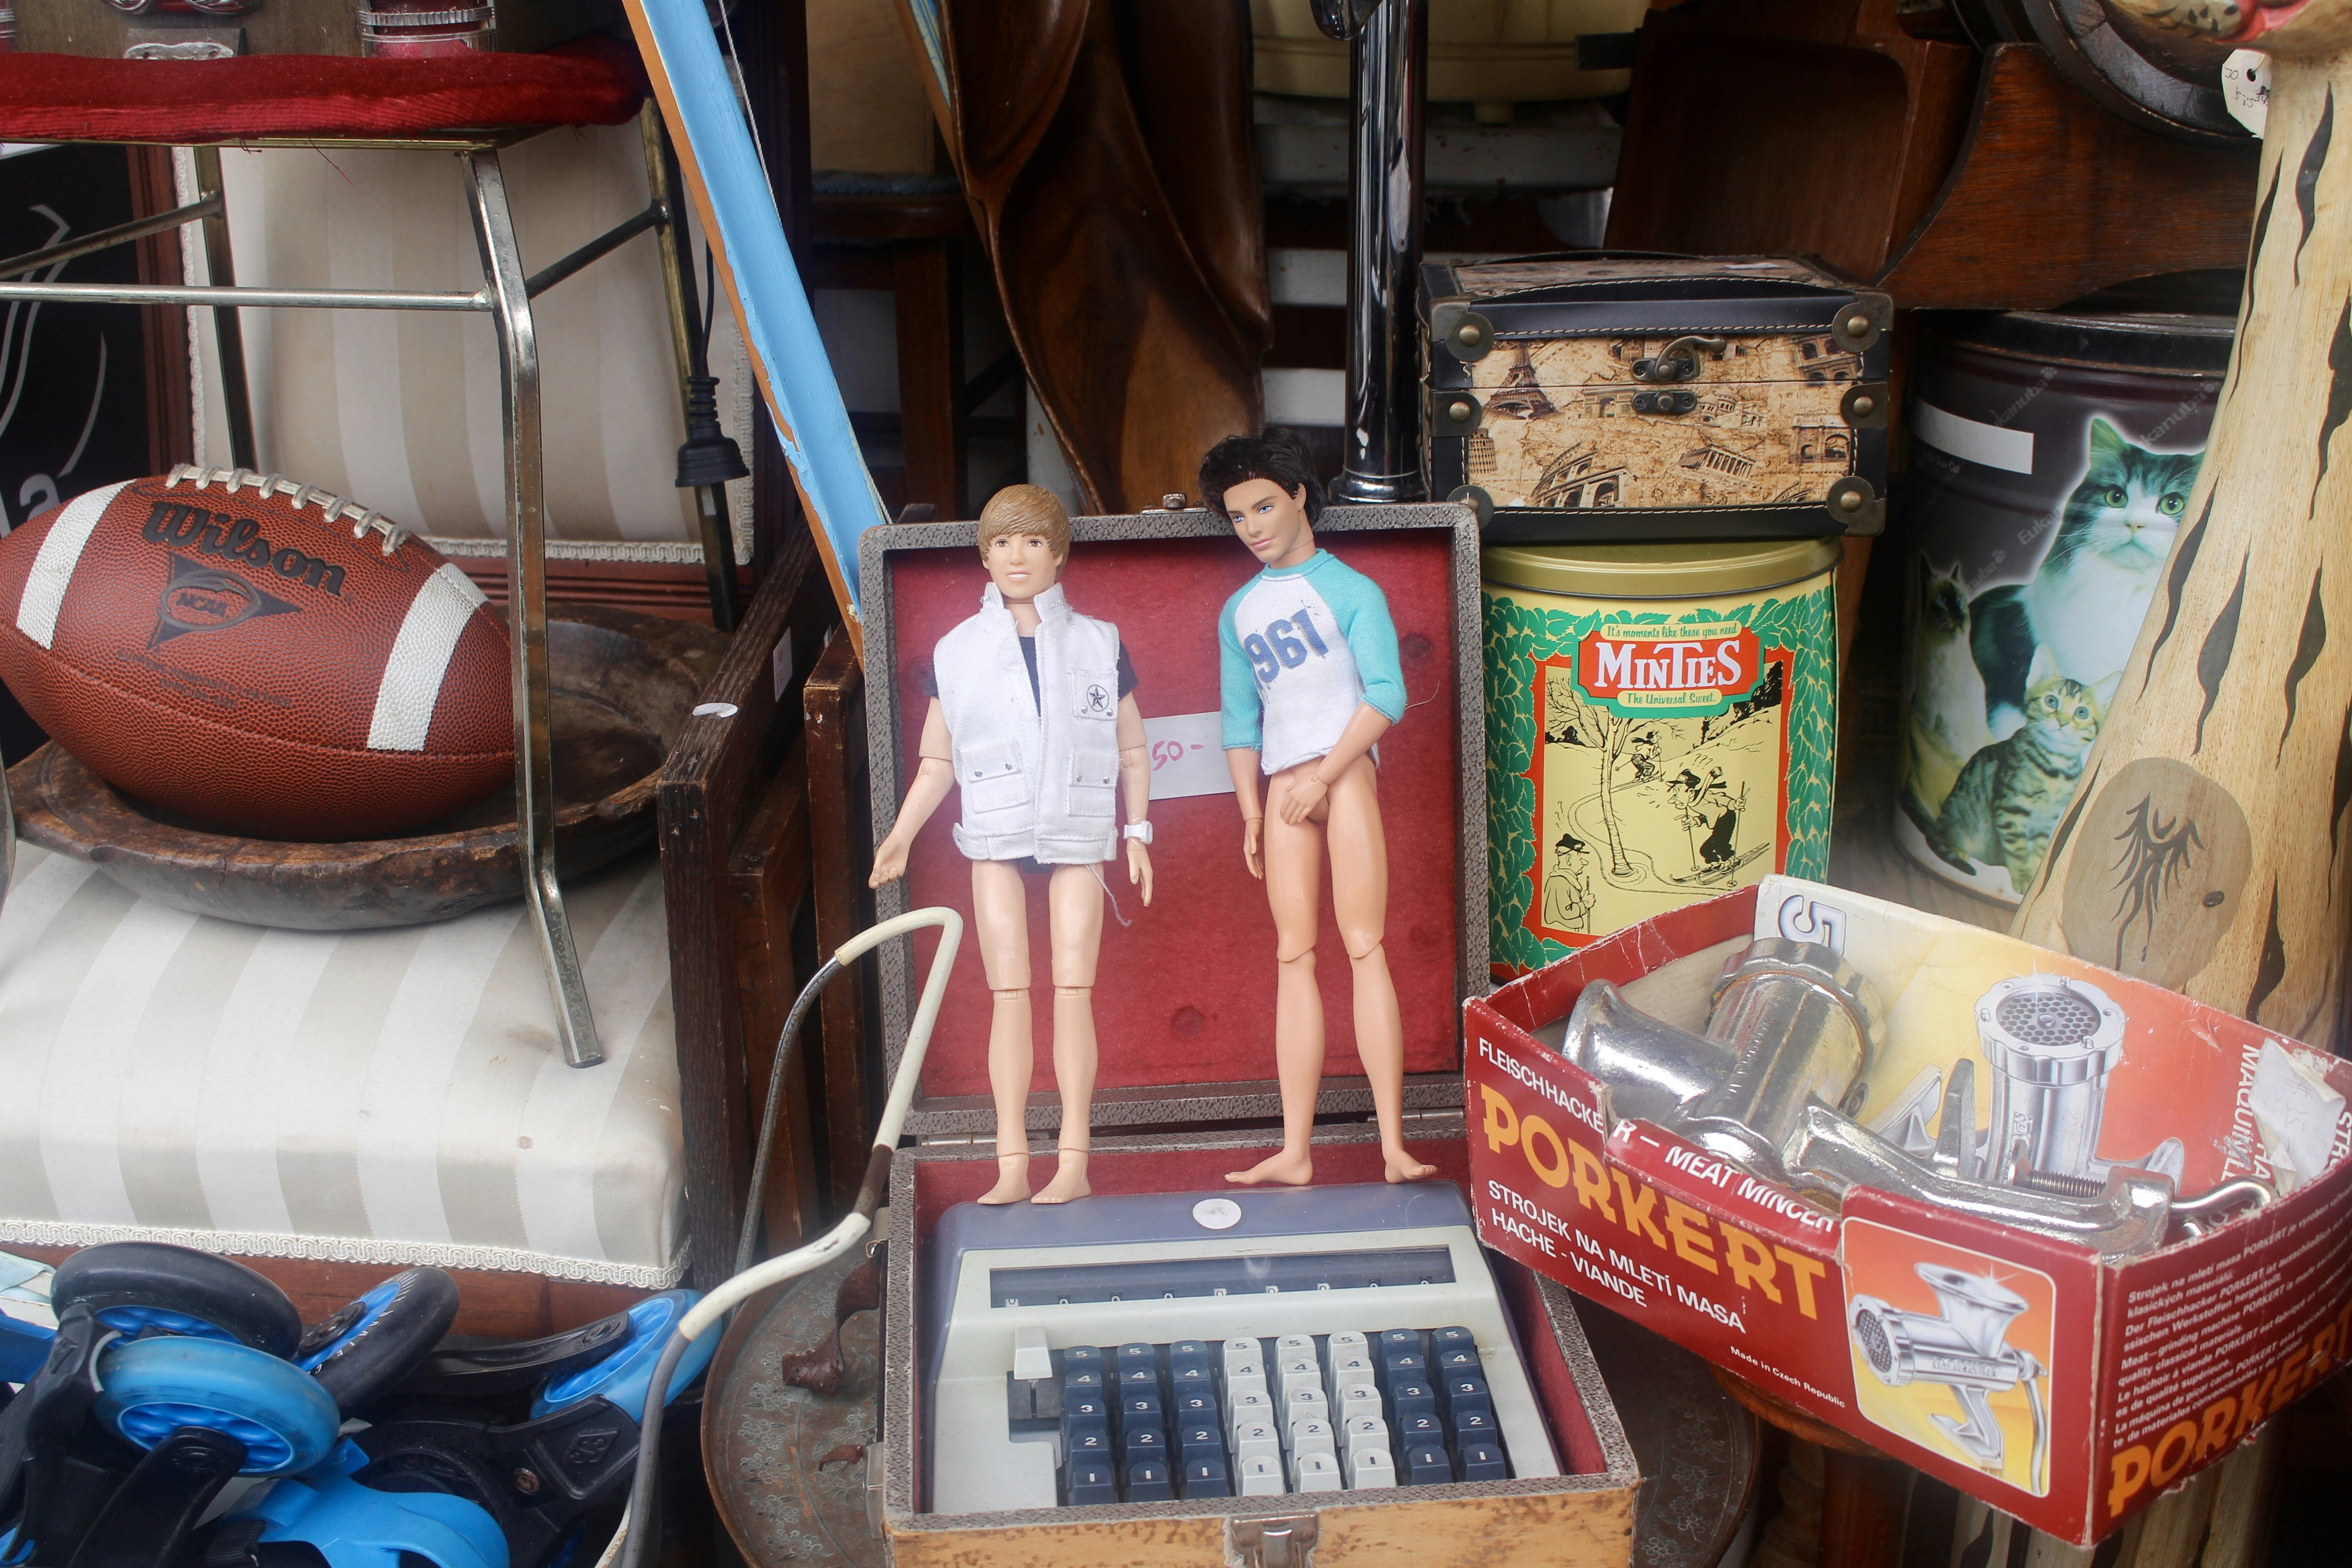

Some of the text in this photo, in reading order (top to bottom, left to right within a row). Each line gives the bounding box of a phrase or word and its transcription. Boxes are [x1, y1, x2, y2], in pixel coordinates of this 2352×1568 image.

[143, 500, 347, 598] Wilson
[1607, 623, 1738, 639] It's moments like these you need
[1626, 692, 1716, 705] The Universal Sweet.
[1665, 1146, 1739, 1188] MEAT
[1481, 1083, 1825, 1320] PORKERT
[1489, 1180, 1746, 1334] STROJEK NA MLETÍ MASA
[1491, 1207, 1556, 1258] HACHE
[1570, 1251, 1647, 1308] VIANDE
[2128, 1281, 2168, 1303] Strojek
[2171, 1278, 2186, 1289] na
[2216, 1253, 2241, 1271] masa
[2243, 1227, 2287, 1258] PORKERT
[2123, 1327, 2169, 1352] ssischen
[2172, 1299, 2233, 1332] Werkstoffen
[2125, 1322, 2146, 1338] Der
[2147, 1294, 2217, 1328] Fleischhacker
[2220, 1267, 2264, 1298] PORKERT
[2201, 1311, 2241, 1336] machine
[2243, 1284, 2285, 1316] PORKERT
[1730, 1346, 1846, 1408] Made in Czech Republic
[2115, 1422, 2128, 1434] La
[2172, 1395, 2185, 1407] de
[2210, 1369, 2234, 1388] carne
[2235, 1340, 2278, 1374] PORKERT
[2117, 1390, 2132, 1403] Le
[2133, 1372, 2171, 1396] hachoir
[2181, 1353, 2214, 1375] viande
[2215, 1326, 2259, 1359] PORKERT
[2260, 1319, 2274, 1334] est
[2118, 1365, 2154, 1388] quality
[2155, 1343, 2198, 1371] classical
[1085, 1437, 1097, 1446] 2
[1141, 1434, 1153, 1442] 2
[1196, 1431, 1208, 1440] 2
[1253, 1428, 1264, 1436] 2
[1363, 1422, 1374, 1430] 2
[1416, 1419, 1430, 1427] 2
[1470, 1416, 1483, 1425] 2
[1136, 1401, 1148, 1410] 3
[2108, 1298, 2352, 1518] PORKERT
[2113, 1437, 2124, 1449] te
[2127, 1430, 2141, 1442] de
[2141, 1405, 2191, 1436] materiales
[2192, 1367, 2258, 1410] convencionales
[2115, 1406, 2128, 1419] es
[2131, 1399, 2145, 1411] de
[2146, 1381, 2180, 1406] qualité
